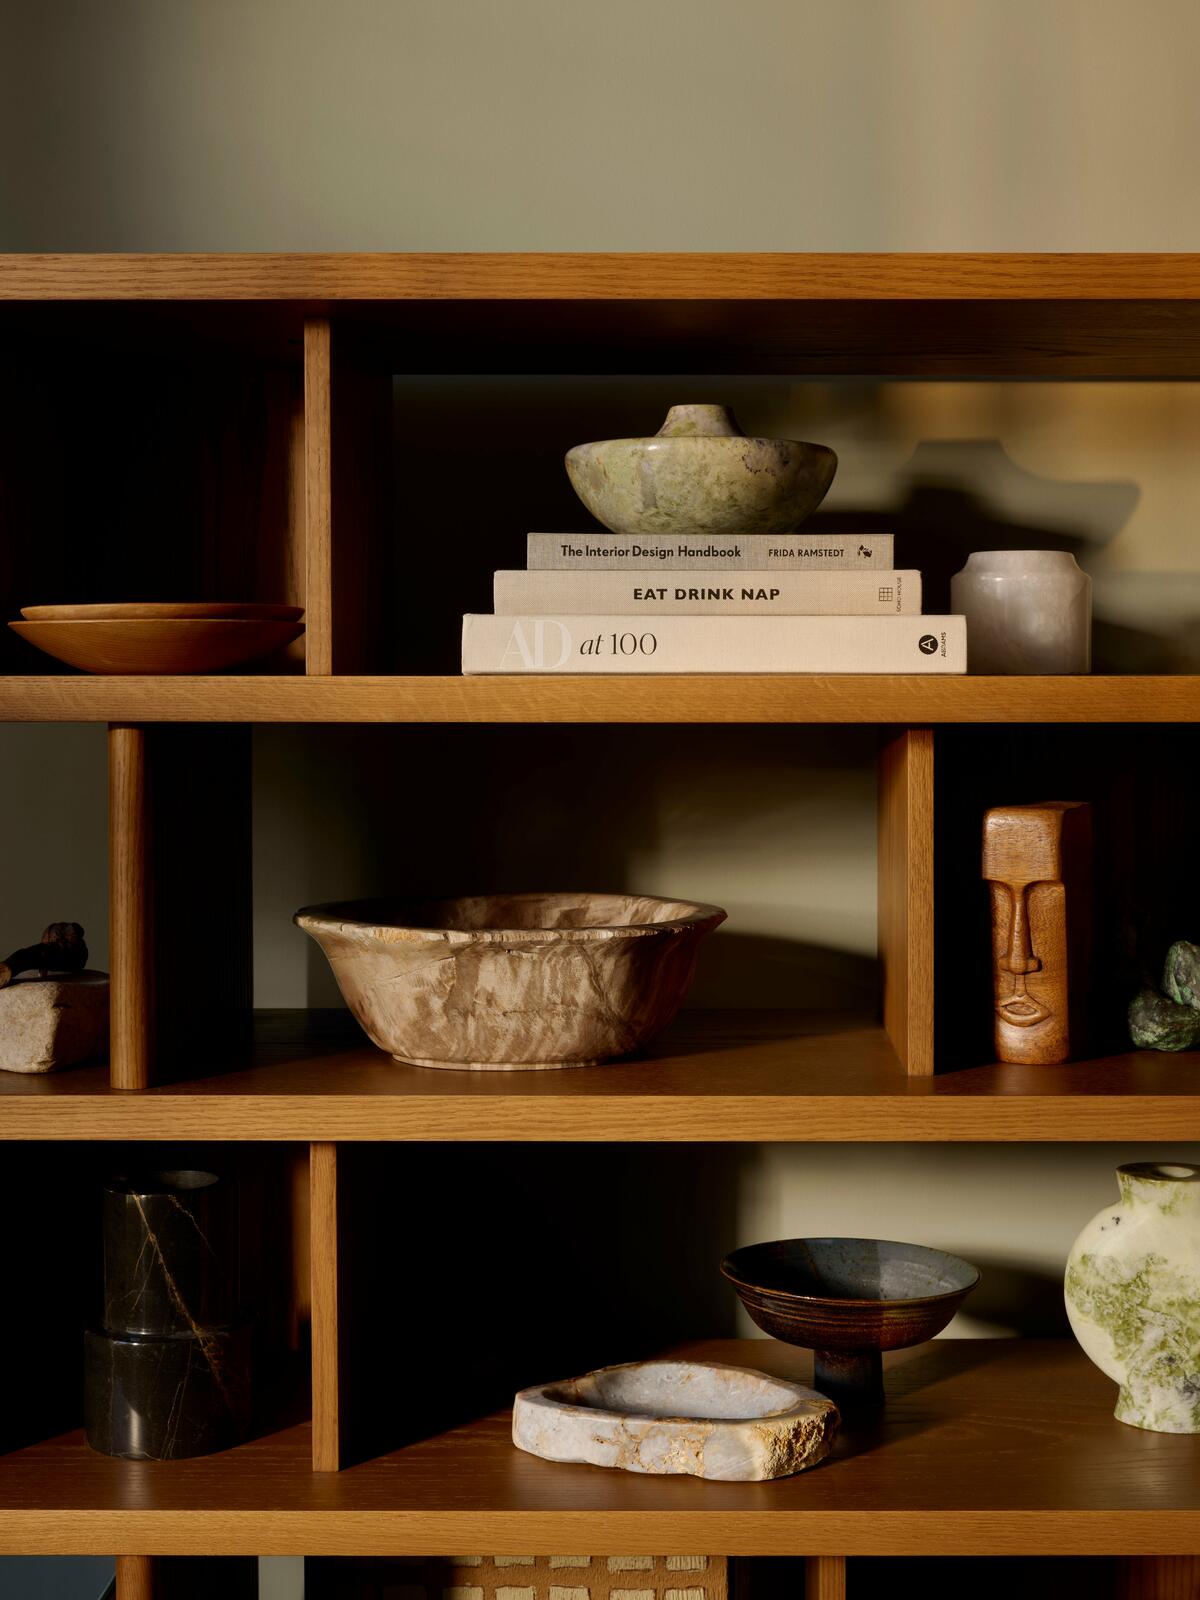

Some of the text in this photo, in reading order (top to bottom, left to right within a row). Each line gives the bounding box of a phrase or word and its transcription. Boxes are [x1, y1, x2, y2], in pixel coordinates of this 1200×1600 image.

[561, 545, 742, 559] The Interior Design Handbook
[768, 549, 844, 557] FRIDA RAMSTEDT
[633, 588, 780, 600] EAT DRINK NAP
[496, 619, 657, 670] AD at 100
